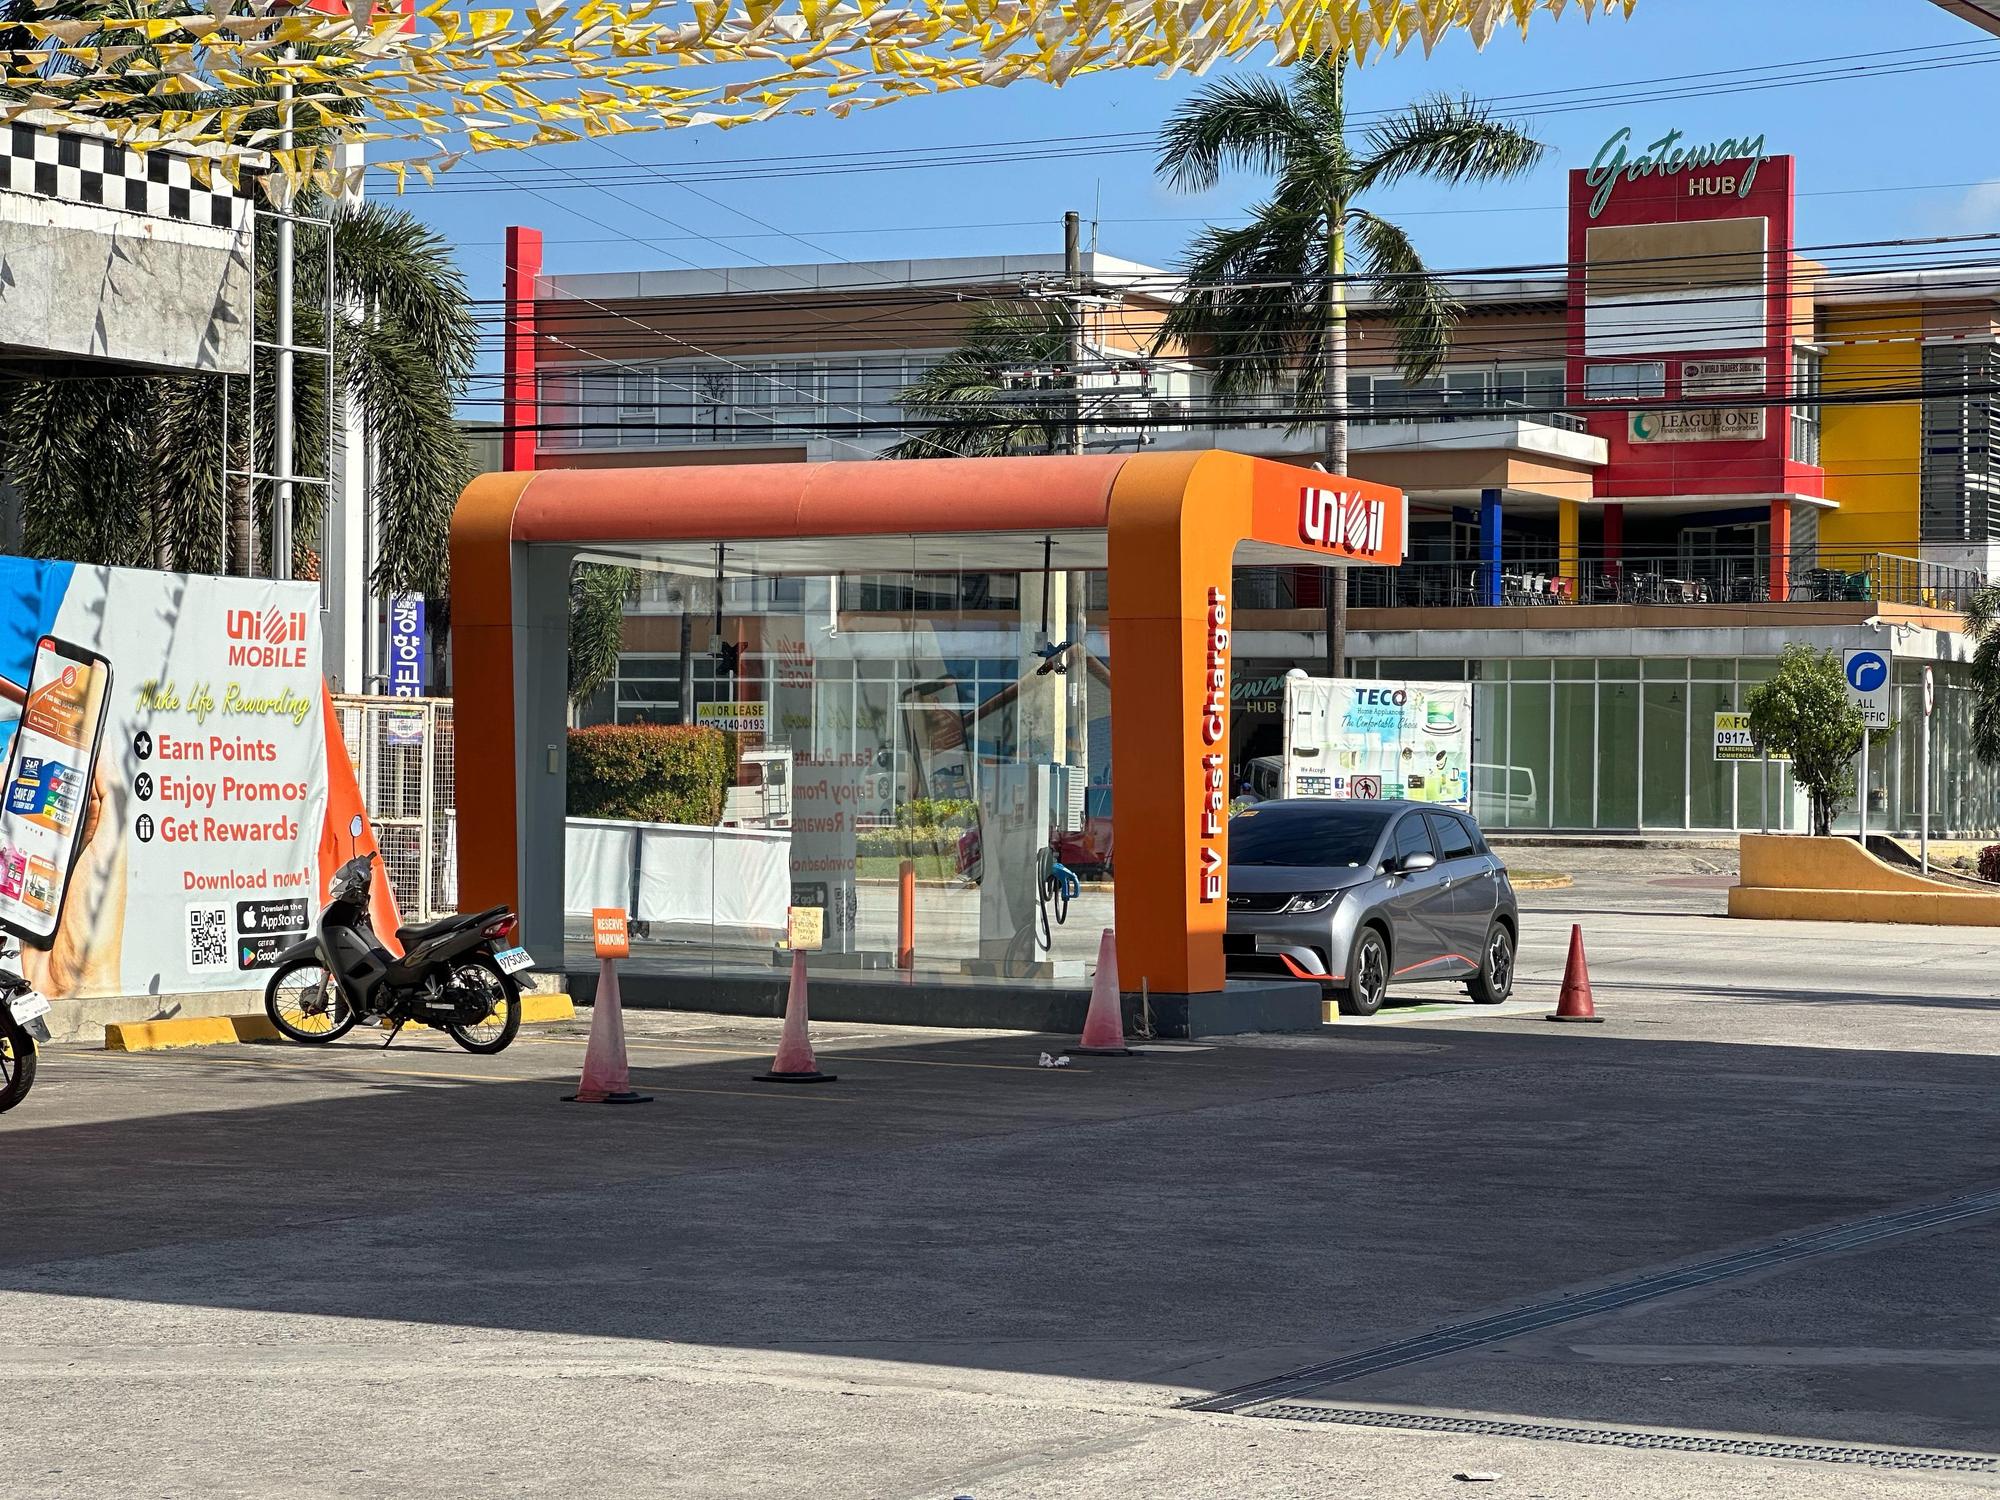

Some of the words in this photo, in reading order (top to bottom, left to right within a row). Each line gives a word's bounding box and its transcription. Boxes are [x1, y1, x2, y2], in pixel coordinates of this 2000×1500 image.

[1586, 127, 1770, 219] Gateway
[1689, 176, 1736, 196] HUB
[1661, 414, 1722, 428] LEAGUE
[1726, 412, 1759, 426] ONE
[1721, 424, 1758, 433] Corporation
[228, 646, 307, 667] MOBILE
[1205, 587, 1229, 743] Charger
[136, 679, 181, 714] Make
[187, 680, 215, 724] Life
[222, 681, 311, 726] Rewarding
[1247, 701, 1277, 713] HUB
[1355, 688, 1407, 706] TECO
[1856, 699, 1875, 709] ALL
[733, 705, 764, 716] LEASE
[1341, 715, 1354, 728] The
[1357, 716, 1394, 731] Comfortable
[1734, 717, 1749, 729] FO
[158, 735, 204, 760] Earn
[210, 736, 276, 762] Points
[160, 775, 216, 808] Enjoy
[223, 776, 308, 801] Promos
[1203, 753, 1224, 836] Fast
[160, 816, 198, 843] Get
[204, 815, 298, 843] Rewards
[184, 868, 267, 890] Download
[273, 867, 311, 887] now!
[1203, 847, 1222, 900] EV
[597, 918, 624, 930] RESERVE
[598, 933, 625, 945] PARKING
